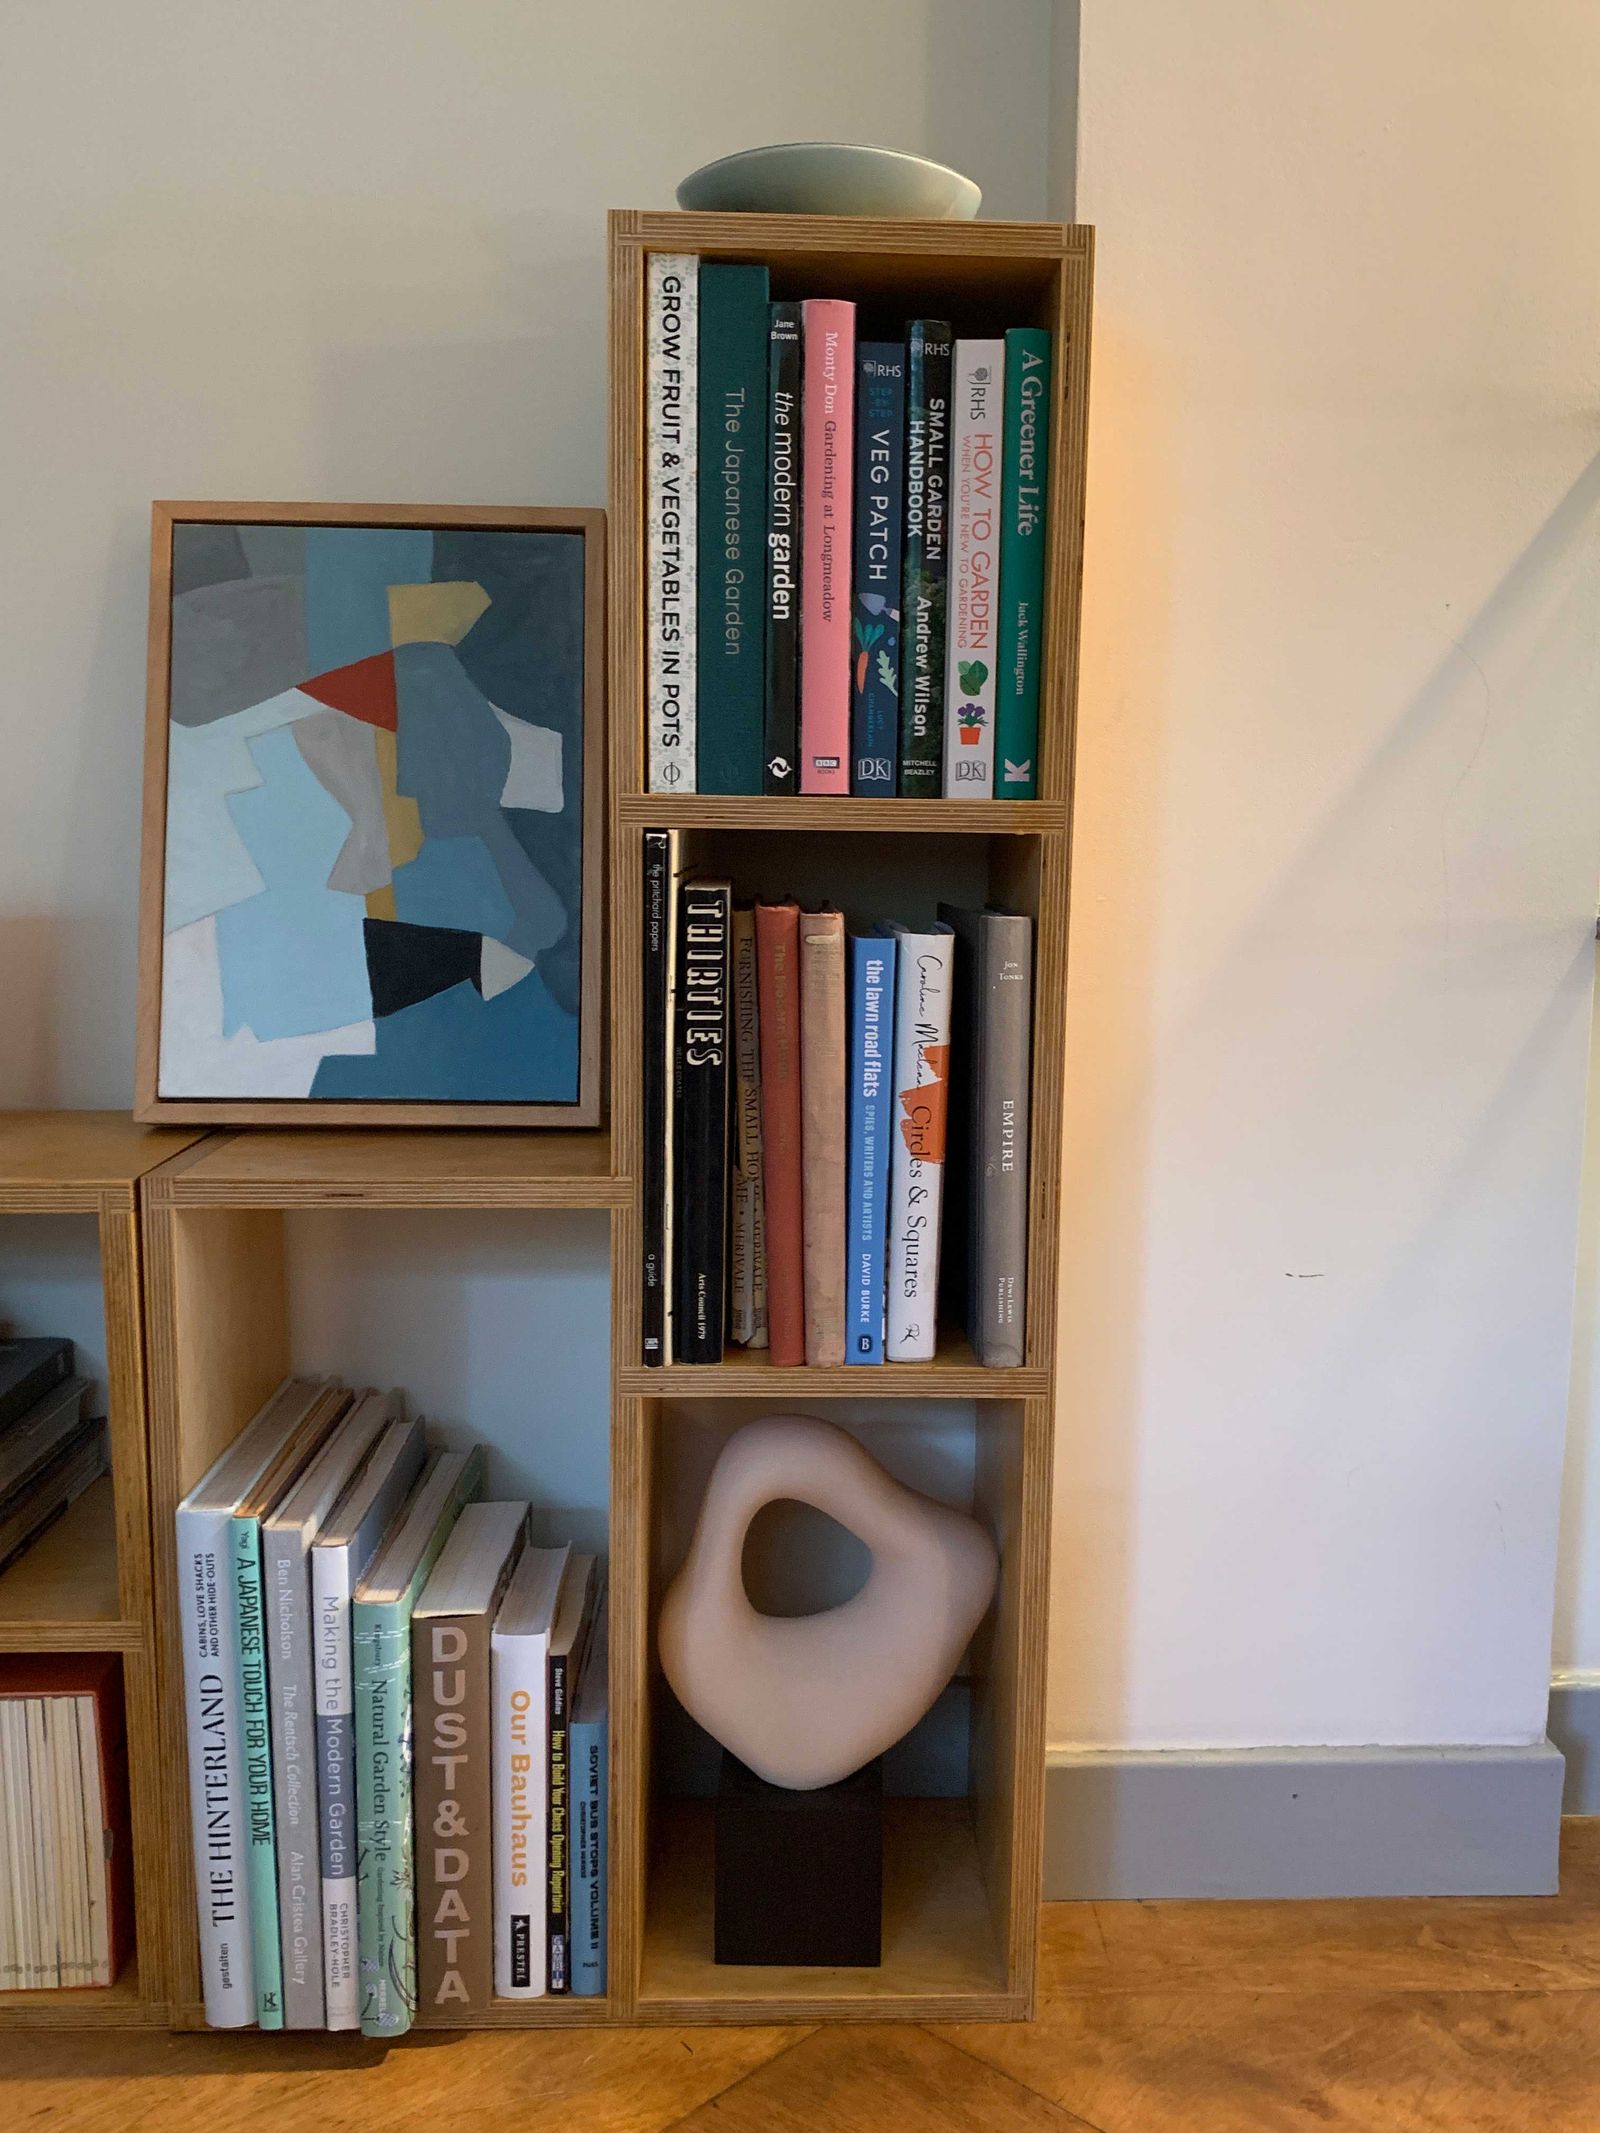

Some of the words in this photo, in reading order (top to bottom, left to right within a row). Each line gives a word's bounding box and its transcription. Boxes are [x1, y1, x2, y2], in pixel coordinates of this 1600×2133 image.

[662, 276, 681, 361] GROW
[770, 331, 799, 342] Brown
[774, 319, 795, 330] Jane
[822, 332, 838, 382] Monty
[924, 342, 950, 356] RHS
[1022, 350, 1043, 372] A
[877, 364, 902, 378] RHS
[662, 369, 681, 444] FRUIT
[725, 387, 745, 433] The
[774, 391, 794, 426] the
[824, 384, 838, 414] Don
[970, 387, 987, 421] RHS
[928, 398, 945, 468] SMALL
[1019, 376, 1043, 480] Greener
[662, 452, 681, 468] &
[821, 420, 837, 500] Gardening
[870, 429, 890, 484] VEG
[962, 435, 971, 473] WHEN
[973, 434, 993, 499] HOW
[721, 441, 745, 560] Japanese
[773, 432, 797, 526] modern
[907, 420, 926, 538] HANDBOOK
[960, 478, 971, 520] YOU'RE
[823, 504, 835, 519] at
[926, 476, 943, 560] GARDEN
[971, 508, 992, 541] TO
[1016, 485, 1040, 536] Life
[868, 495, 889, 580] PATCH
[959, 523, 969, 552] NEW
[662, 477, 681, 642] VEGETABLES
[768, 532, 795, 620] garden
[821, 525, 836, 622] Longmeadow
[958, 558, 969, 573] TO
[725, 568, 744, 655] Garden
[957, 578, 969, 649] GARDENING
[969, 551, 991, 650] GARDEN
[1017, 600, 1029, 628] Jack
[914, 596, 933, 670] Andrew
[662, 651, 680, 675] IN
[1014, 628, 1030, 695] Wallington
[662, 684, 680, 748] POTS
[913, 675, 931, 737] Wilson
[860, 758, 889, 777] DK
[902, 759, 938, 768] MITCHELL
[903, 768, 936, 776] BEAZLEY
[958, 761, 985, 778] DK
[652, 864, 661, 878] the
[650, 880, 662, 921] pritchard
[648, 922, 660, 952] papers
[686, 900, 724, 1066] THIRTIES
[739, 938, 754, 1043] FURNISHING
[865, 959, 884, 984] the
[914, 954, 943, 1018] Caroline
[864, 987, 884, 1022] lawn
[863, 1024, 882, 1058] road
[742, 1048, 756, 1083] THE
[862, 1060, 883, 1098] flats
[744, 1088, 759, 1145] SMALL
[1001, 1100, 1015, 1173] EMPIRE
[863, 1136, 875, 1179] WRITERS
[908, 1105, 932, 1179] Circles
[863, 1180, 874, 1199] AND
[907, 1185, 929, 1208] &
[861, 1201, 873, 1241] ARTISTS
[647, 1262, 658, 1287] guide
[735, 1222, 746, 1294] MERIVALE
[861, 1253, 872, 1286] DAVID
[901, 1214, 928, 1298] Squares
[698, 1273, 707, 1290] Arts
[698, 1290, 707, 1321] Council
[860, 1288, 871, 1323] BURKE
[697, 1321, 706, 1340] 1979
[193, 1552, 204, 1592] SHACKS
[205, 1552, 217, 1604] HIDE-OUTS
[237, 1557, 257, 1571] A
[277, 1558, 292, 1585] Ben
[195, 1594, 206, 1618] LOVE
[208, 1605, 219, 1636] OTHER
[236, 1575, 260, 1655] JAPANESE
[278, 1588, 297, 1660] Nicholson
[197, 1619, 208, 1658] CABINS,
[209, 1637, 220, 1657] AND
[321, 1596, 339, 1670] Making
[242, 1661, 263, 1715] TOUCH
[283, 1684, 297, 1709] The
[325, 1673, 343, 1711] the
[554, 1667, 564, 1688] Steve
[371, 1679, 389, 1746] Natural
[431, 1626, 469, 1791] DUST
[509, 1690, 531, 1746] Our
[245, 1719, 266, 1750] FOR
[283, 1711, 300, 1760] Rentsch
[552, 1730, 565, 1751] How
[200, 1674, 232, 1861] HINTERLAND
[248, 1753, 269, 1796] YOUR
[326, 1717, 344, 1796] Modern
[552, 1752, 565, 1762] to
[552, 1764, 565, 1785] Build
[589, 1745, 598, 1795] SOVIET
[286, 1761, 302, 1825] Collection
[371, 1751, 391, 1814] Garden
[552, 1788, 565, 1805] Your
[251, 1802, 271, 1846] HOME
[432, 1799, 471, 1838] &
[510, 1754, 533, 1888] Bauhaus
[552, 1807, 565, 1833] Chess
[590, 1800, 599, 1829] BUS
[328, 1803, 348, 1876] Garden
[369, 1821, 392, 1861] Style
[549, 1834, 565, 1868] Opening
[590, 1832, 600, 1877] STOPS
[290, 1850, 304, 1881] Alan
[209, 1869, 235, 1928] THE
[290, 1883, 307, 1934] Cristea
[549, 1869, 565, 1914] Repertoire
[590, 1880, 600, 1939] VOLUME
[329, 1903, 341, 1989] BRADLEY-HOLE
[338, 1902, 351, 1979] CHRISTOPHER
[433, 1848, 471, 2005] DATA
[218, 1943, 233, 1989] gestalten
[291, 1935, 309, 1985] Gallery
[515, 1933, 525, 1982] PRESTEL
